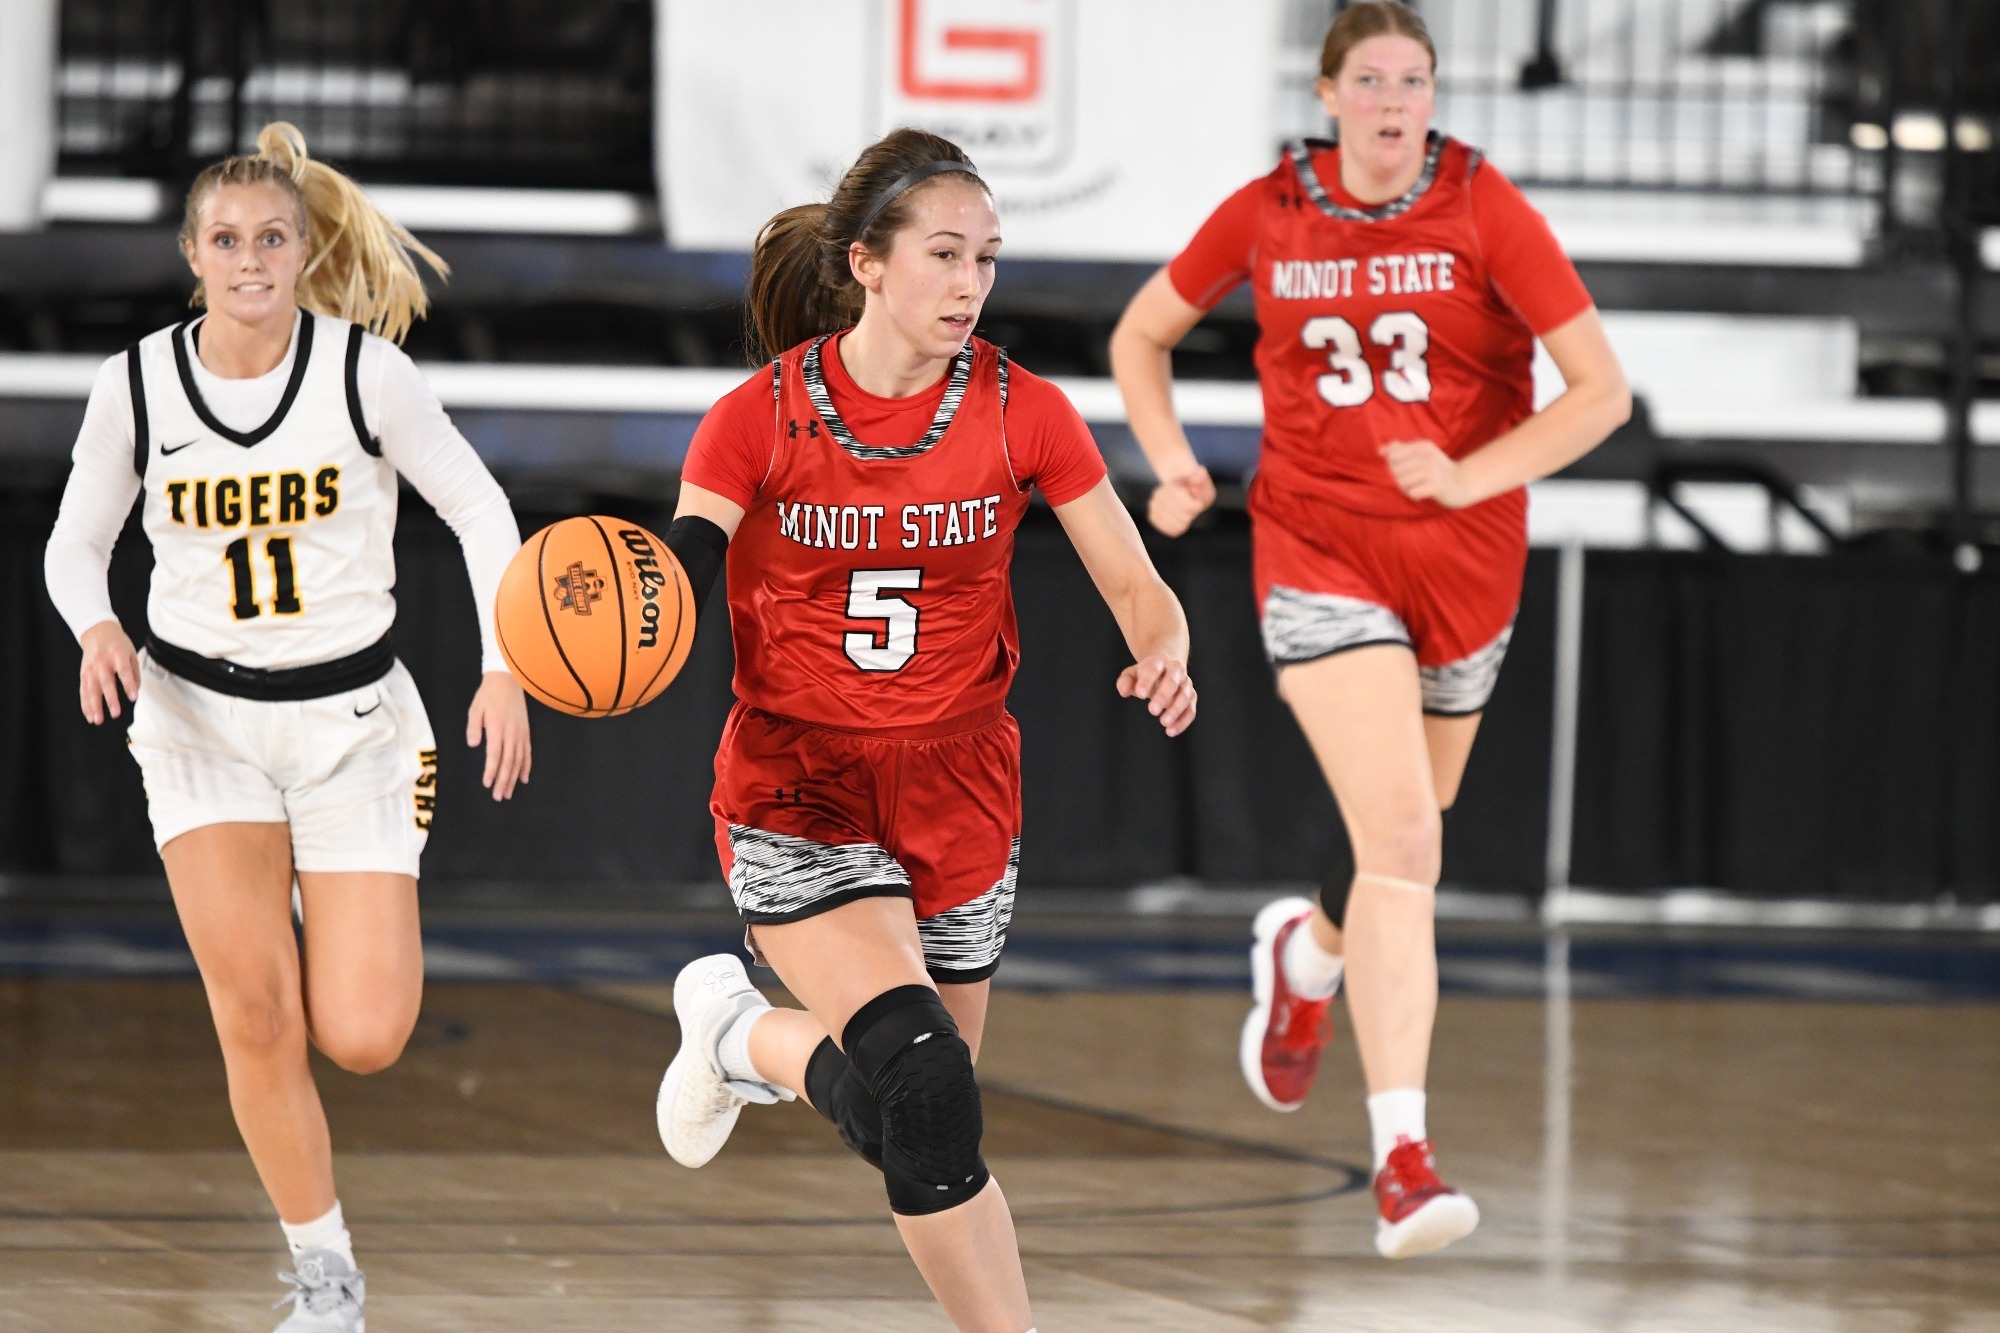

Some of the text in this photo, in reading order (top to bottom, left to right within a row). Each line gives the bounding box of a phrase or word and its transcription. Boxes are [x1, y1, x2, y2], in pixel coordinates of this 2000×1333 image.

[1272, 252, 1455, 299] MINOT STATE
[1301, 310, 1432, 408] 33
[166, 465, 340, 528] TIGERS
[777, 494, 1001, 550] MINOT STATE
[223, 534, 304, 621] 11
[619, 530, 665, 649] Wilson
[842, 567, 925, 673] 5
